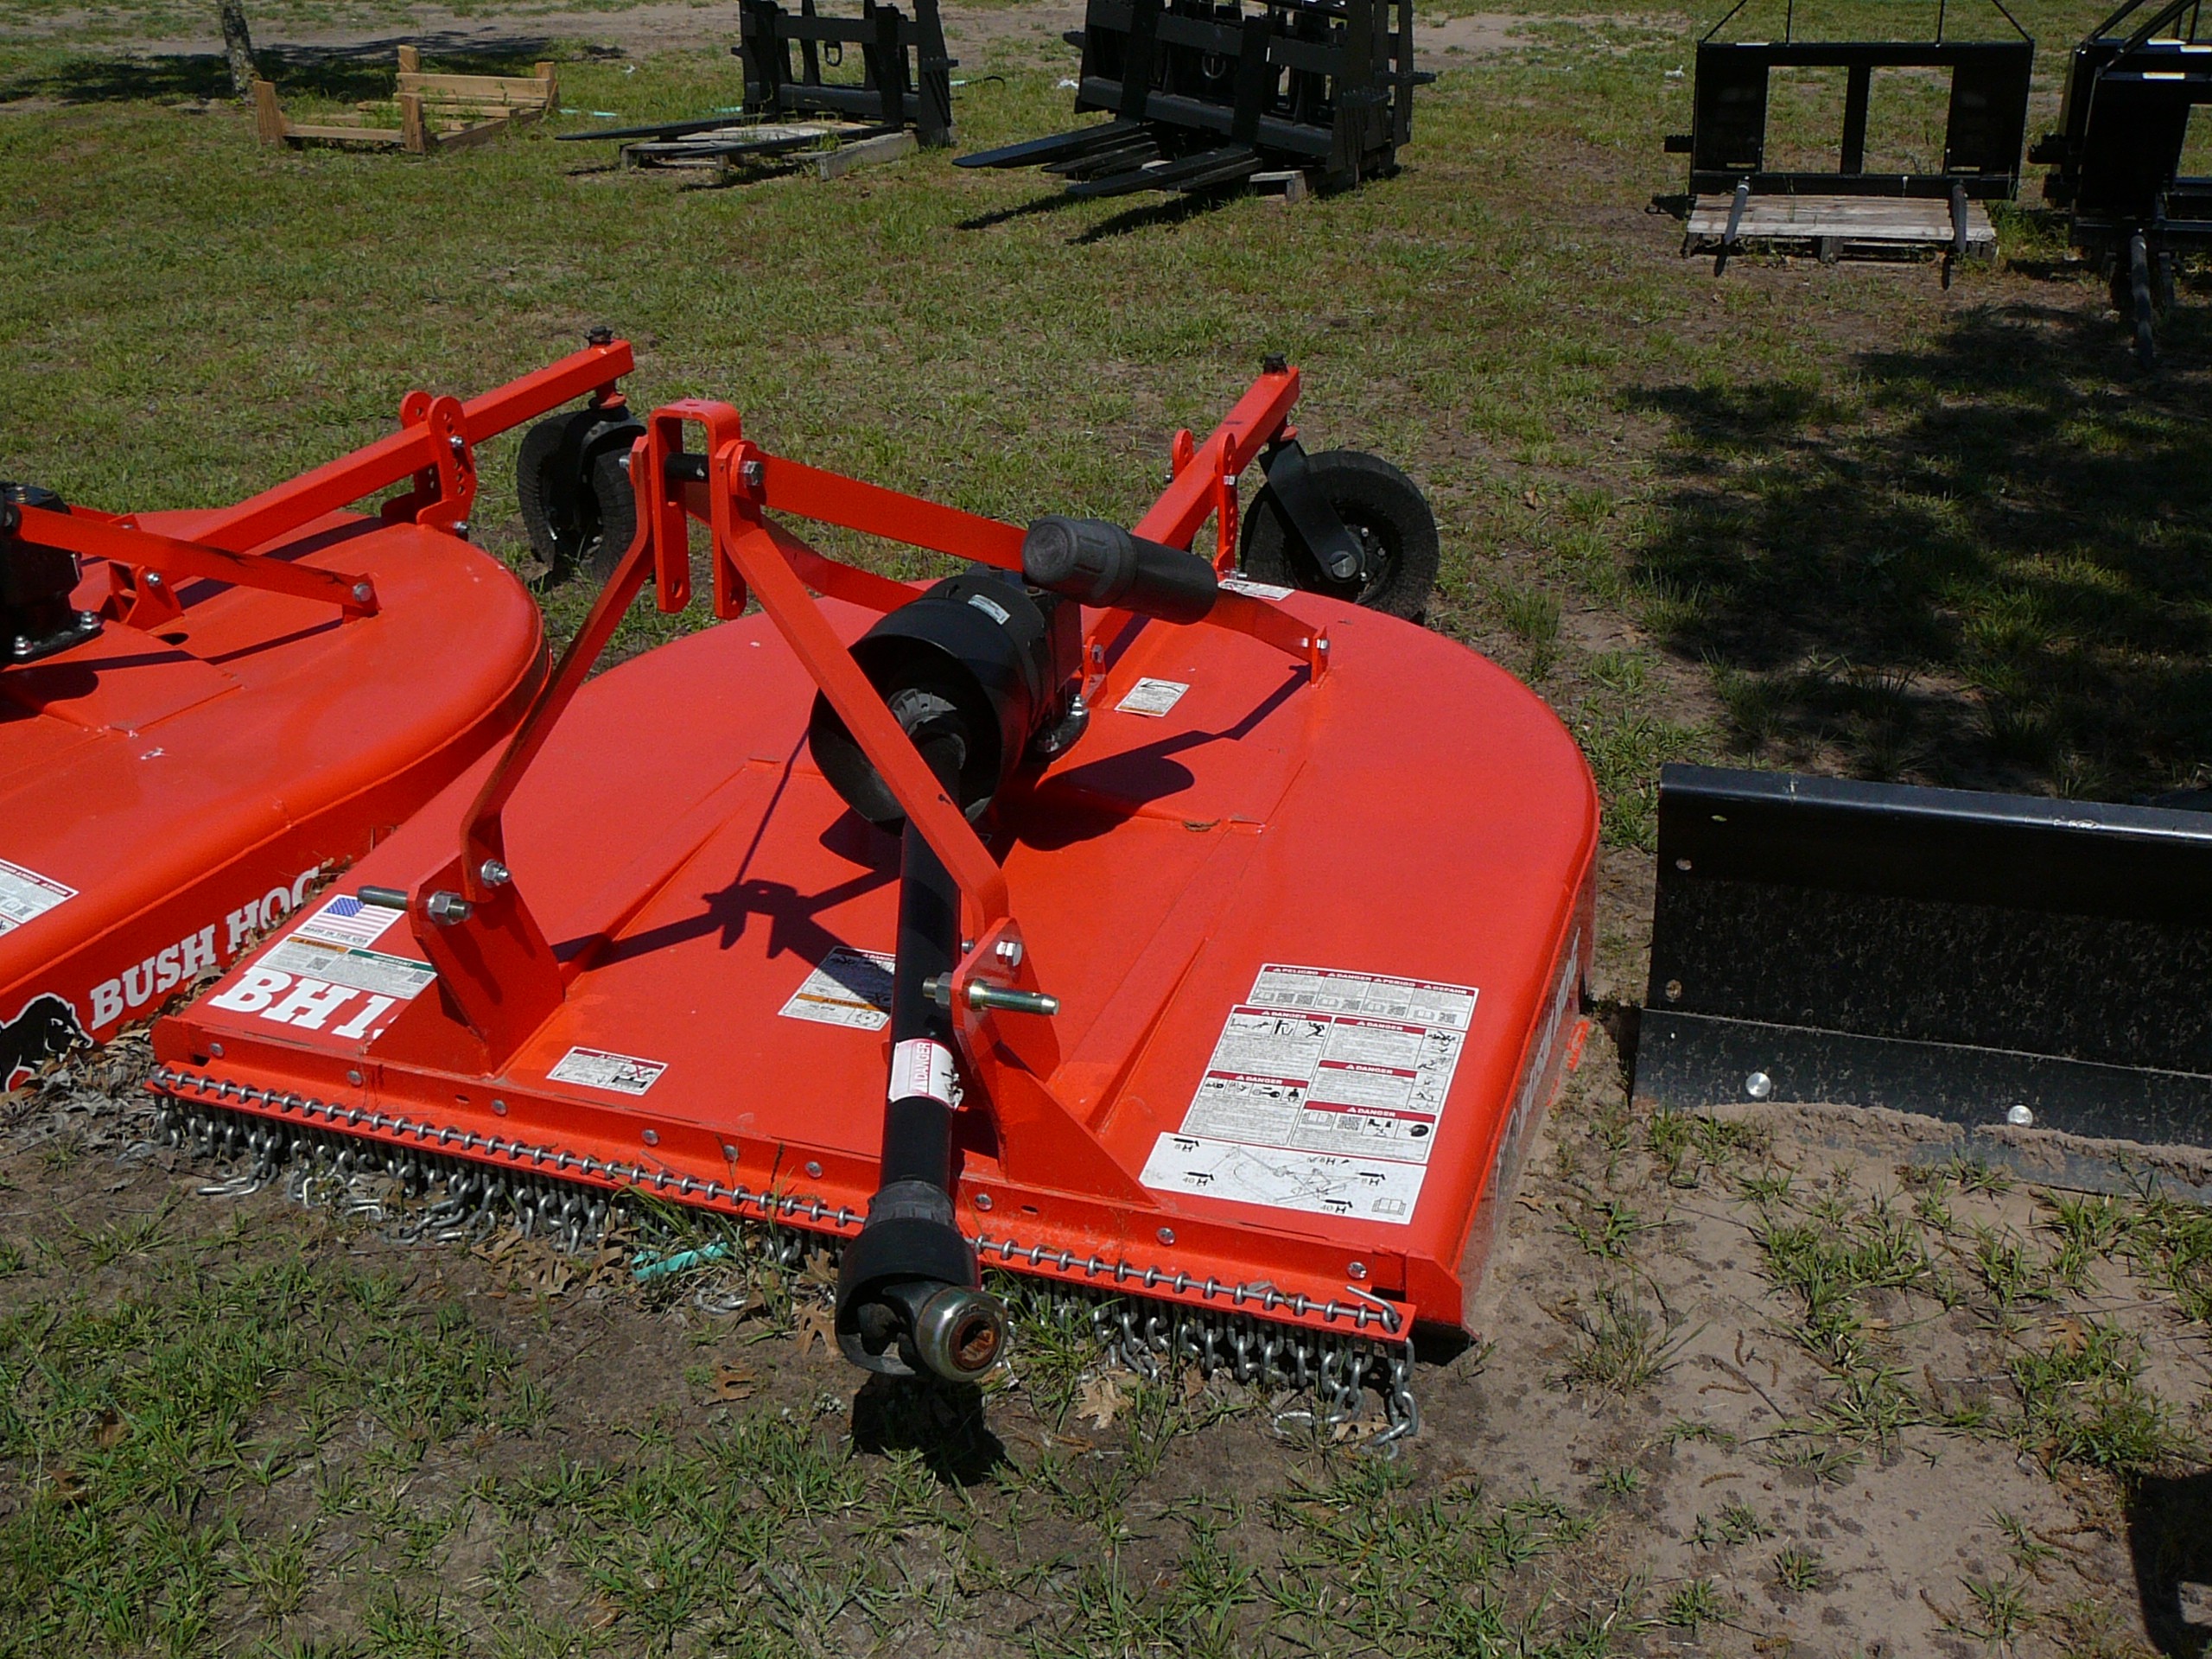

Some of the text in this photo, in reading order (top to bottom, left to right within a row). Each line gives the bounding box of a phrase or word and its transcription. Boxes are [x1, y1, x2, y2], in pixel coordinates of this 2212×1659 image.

[90, 924, 217, 1031] BUSH
[1336, 973, 1372, 982] DANGER
[208, 965, 399, 1040] BH1
[1270, 1011, 1307, 1020] DANGER
[1366, 1021, 1403, 1031] DANGER
[913, 1042, 931, 1081] DANGER
[1355, 1065, 1393, 1075] DANGER
[1245, 1075, 1283, 1084] DANGER
[1357, 1108, 1396, 1117] DANGER
